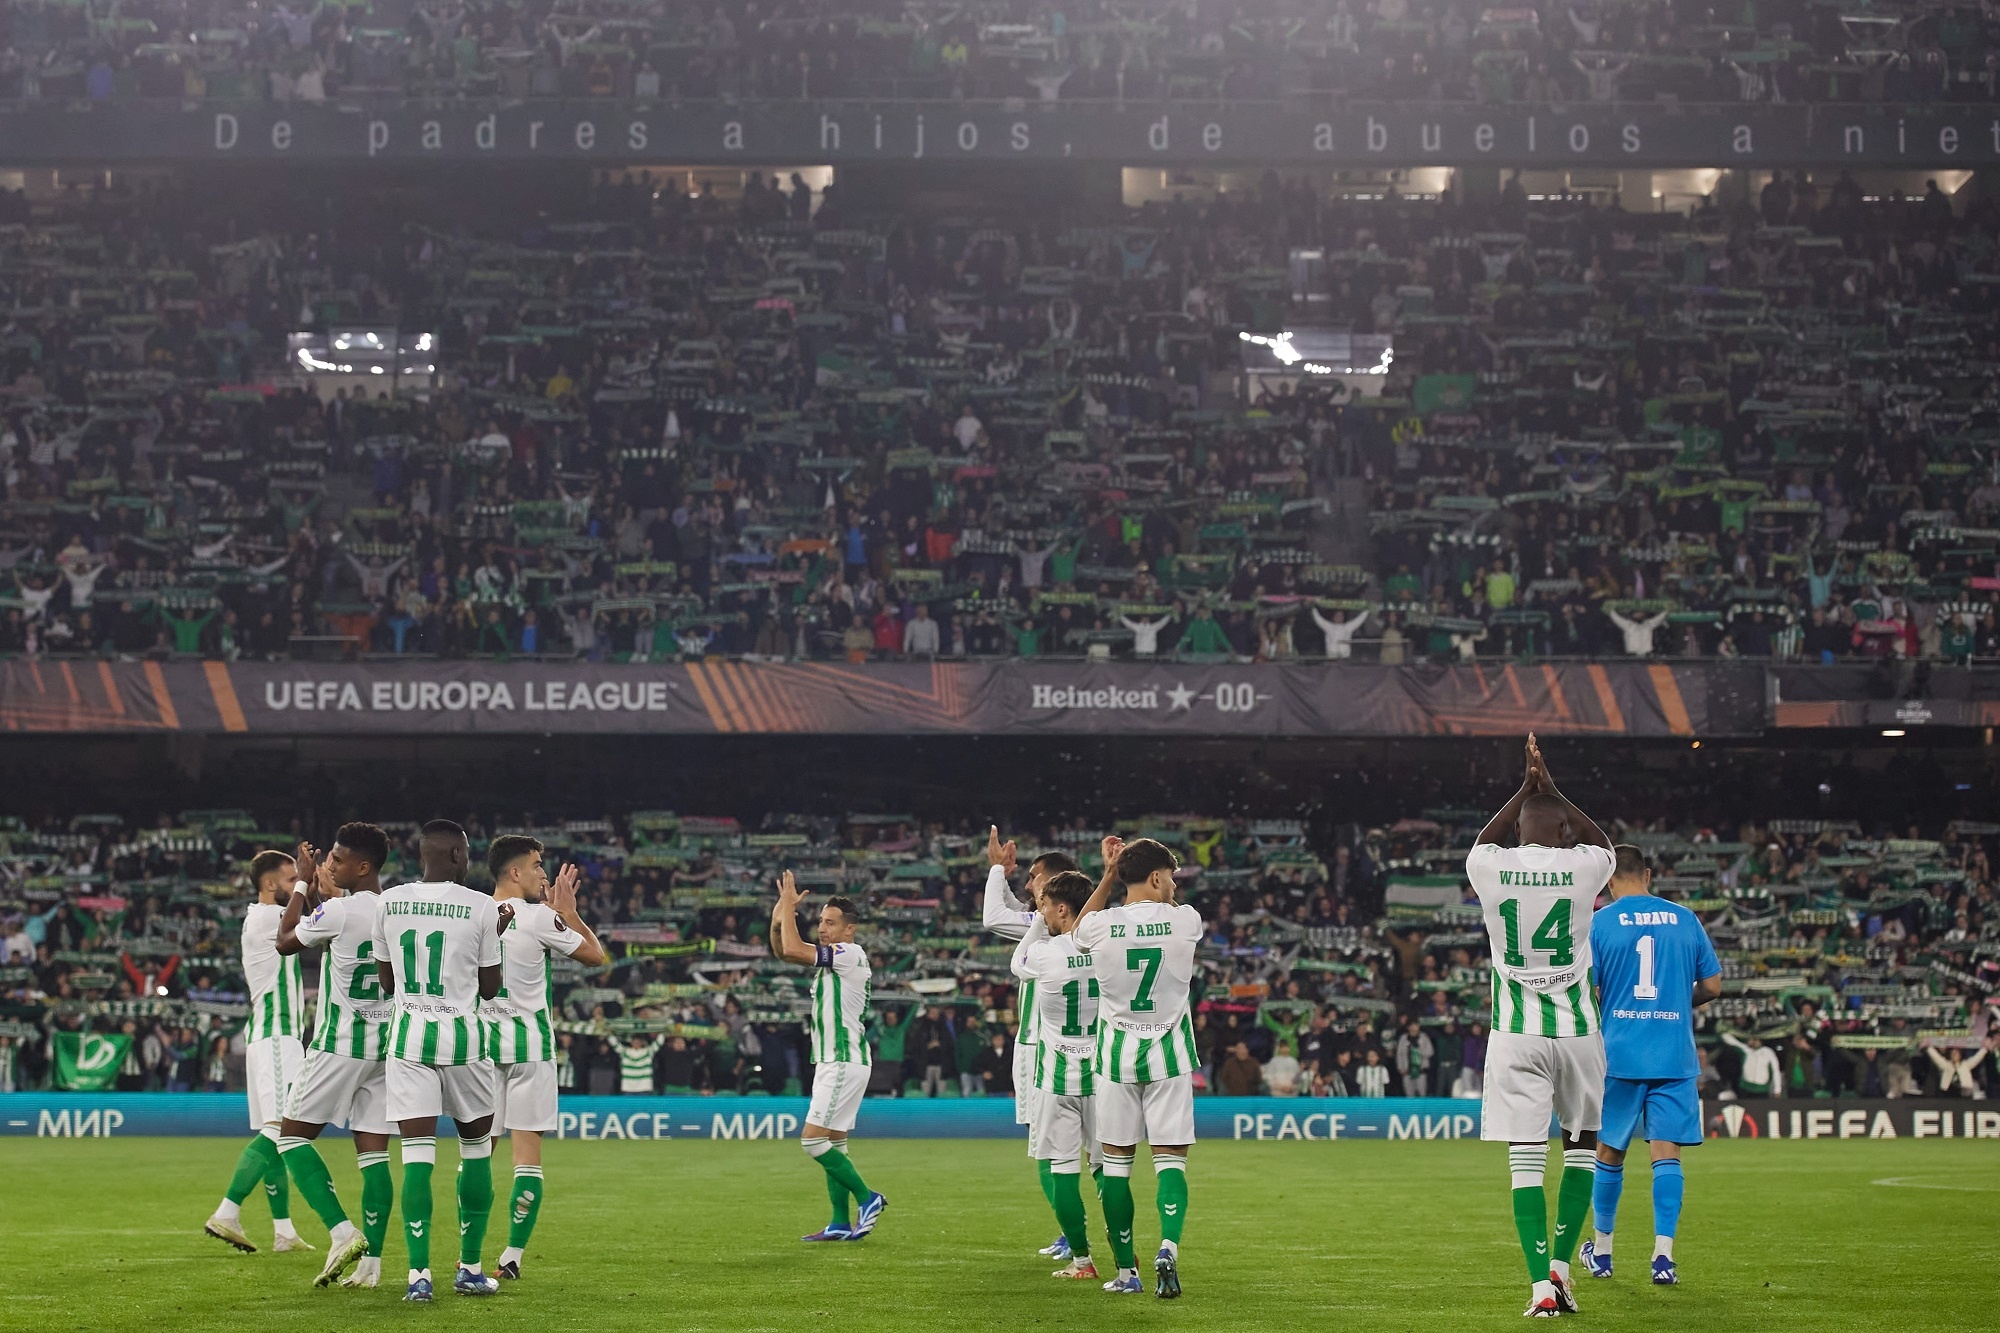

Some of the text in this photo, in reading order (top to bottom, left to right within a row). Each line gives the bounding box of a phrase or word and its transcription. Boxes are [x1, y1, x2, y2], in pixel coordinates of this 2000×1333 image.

[215, 113, 292, 149] De
[370, 114, 647, 155] padres
[723, 122, 743, 149] a
[821, 114, 1072, 158] hijos,
[1147, 114, 1223, 152] de
[1313, 122, 1335, 152] a
[1366, 116, 1640, 152] abuelos
[1733, 125, 1754, 153] a
[266, 681, 668, 711] UEFA EUROPA LEAGUE
[1032, 684, 1158, 709] Heineken
[1499, 870, 1574, 886] WILLIAM
[386, 902, 471, 919] LUIZ HENRIQUE
[1619, 911, 1678, 926] C. BRAVO
[1110, 922, 1172, 938] EZ ABDE
[1499, 898, 1576, 969] 14
[349, 940, 394, 1002] 2
[400, 929, 446, 999] 11
[1067, 954, 1094, 968] ROD
[1634, 935, 1658, 1000] 1
[1126, 947, 1166, 1013] 7
[1613, 1009, 1679, 1020] FOREVER GREEN
[38, 1108, 124, 1138] МИР
[558, 1112, 671, 1140] PEACE
[711, 1112, 797, 1140] МИР
[1234, 1113, 1347, 1140] PEACE
[1388, 1114, 1474, 1140] МИР
[1768, 1110, 2000, 1139] UEFA EUR
